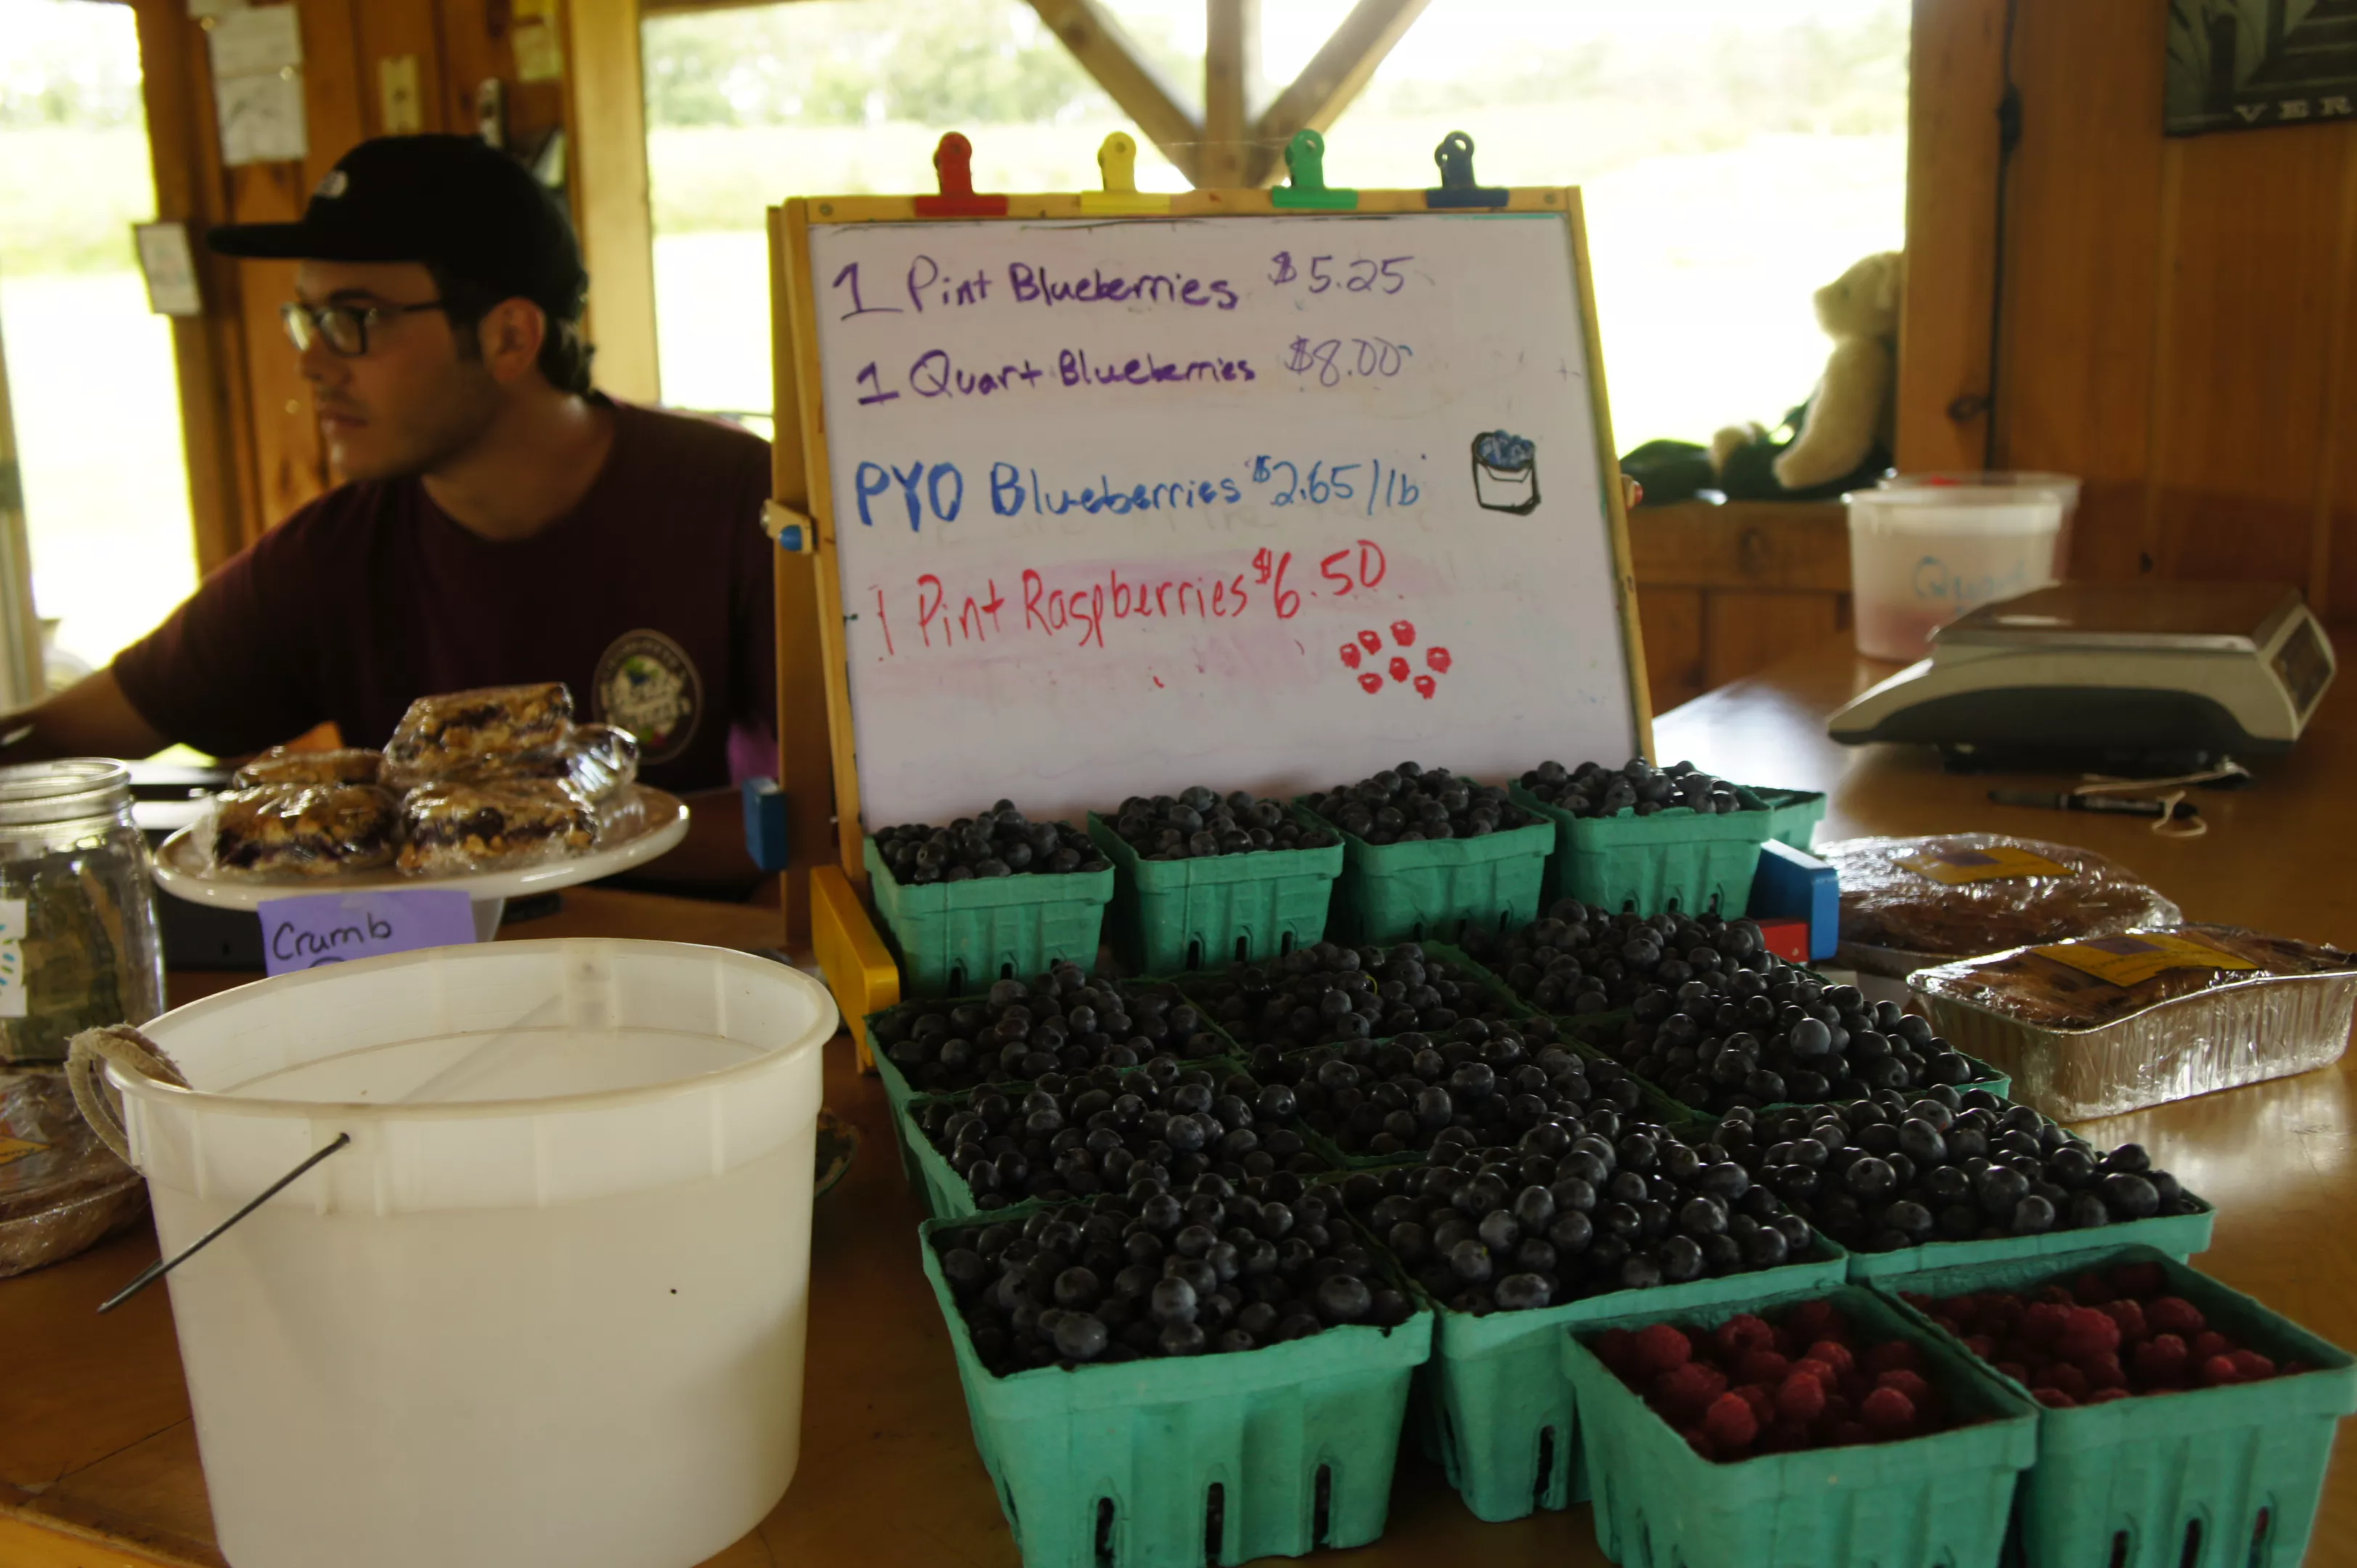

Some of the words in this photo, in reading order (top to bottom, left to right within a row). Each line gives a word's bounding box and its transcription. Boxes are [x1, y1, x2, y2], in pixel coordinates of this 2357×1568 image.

[832, 262, 903, 321] 1
[907, 255, 993, 312] Pint
[1009, 262, 1238, 310] Blueberries
[1268, 251, 1414, 294] $5.25
[857, 362, 900, 405] 1
[910, 349, 1043, 398] Quart
[1059, 349, 1256, 386] Blueberries
[1285, 335, 1402, 387] $8.00
[856, 460, 964, 532] PYO
[990, 462, 1242, 516] Blueberries
[918, 574, 1004, 647] Pint
[1022, 568, 1248, 648] Raspberries
[272, 912, 393, 960] Crumb
